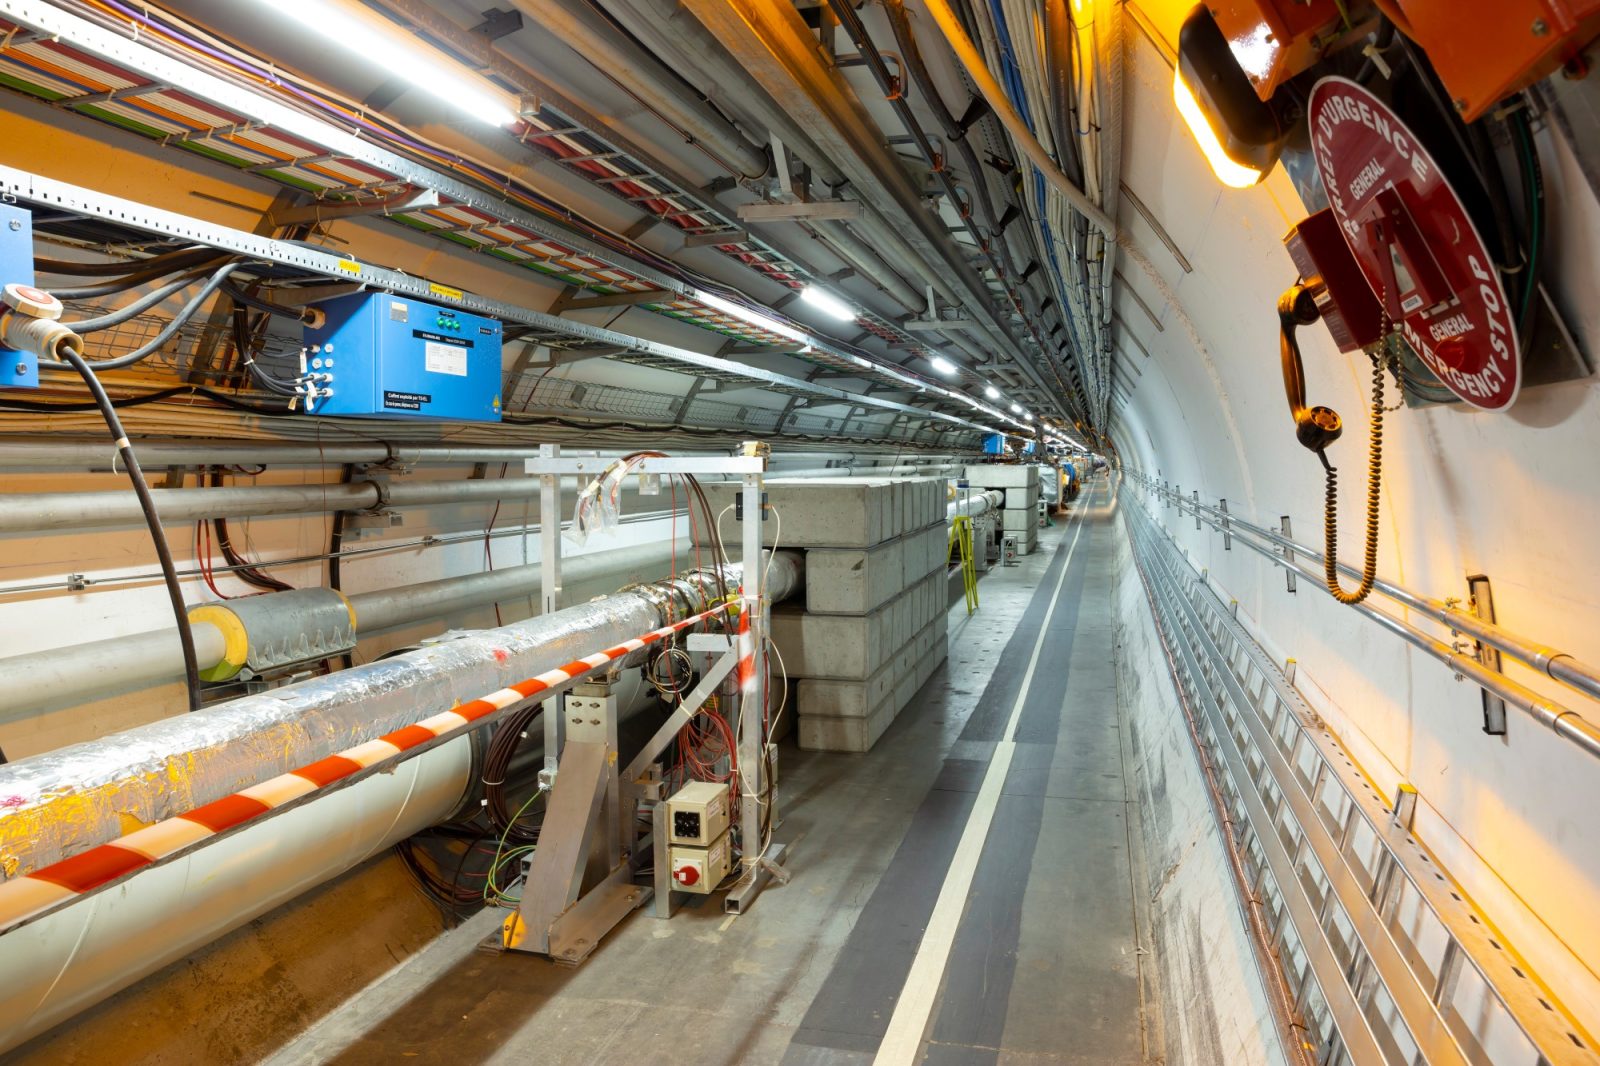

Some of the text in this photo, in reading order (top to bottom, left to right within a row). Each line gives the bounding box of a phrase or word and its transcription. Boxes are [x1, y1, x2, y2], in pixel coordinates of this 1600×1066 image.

[1317, 95, 1429, 240] ARRET D'URGENCE
[1349, 157, 1386, 201] GENERAL
[1403, 254, 1509, 398] MERGENCY STOP
[1428, 312, 1476, 342] GENERAL
